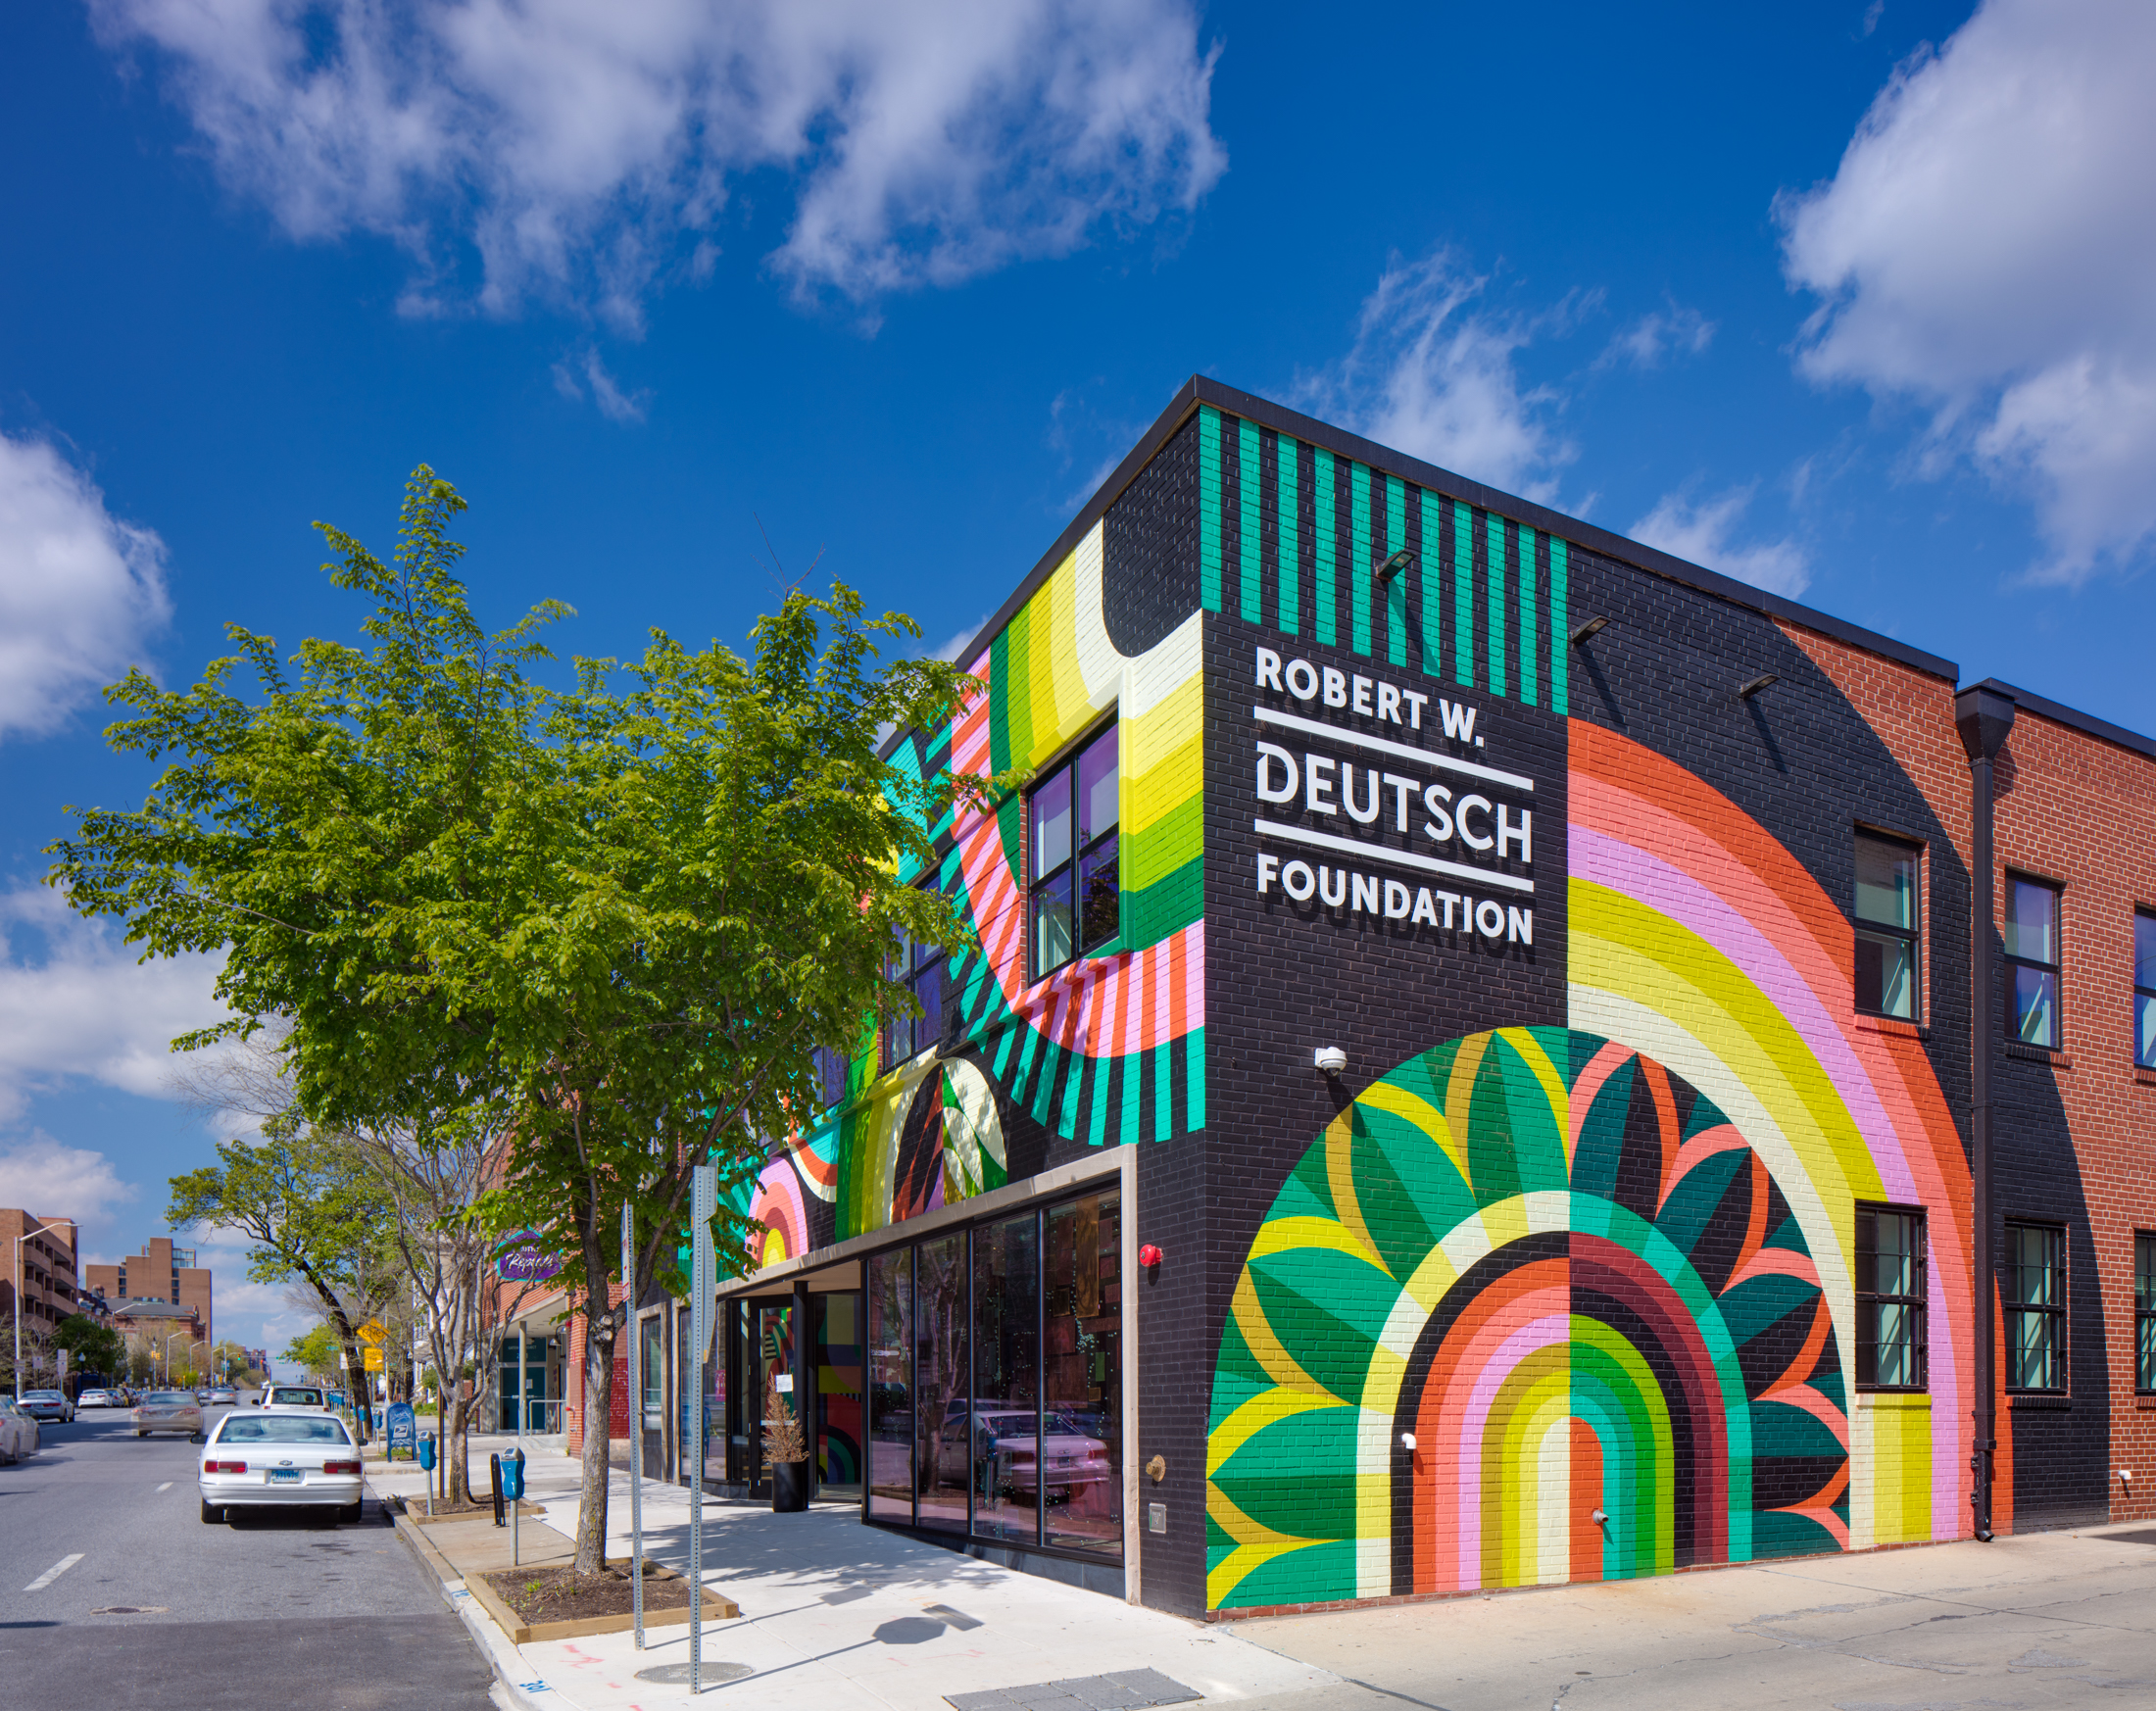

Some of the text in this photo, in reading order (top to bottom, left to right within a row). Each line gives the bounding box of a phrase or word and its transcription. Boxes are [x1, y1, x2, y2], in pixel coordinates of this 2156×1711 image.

[1256, 646, 1485, 748] ROBERT W.
[1256, 741, 1532, 863] DEUTSCH
[1257, 853, 1533, 946] FOUNDATION
